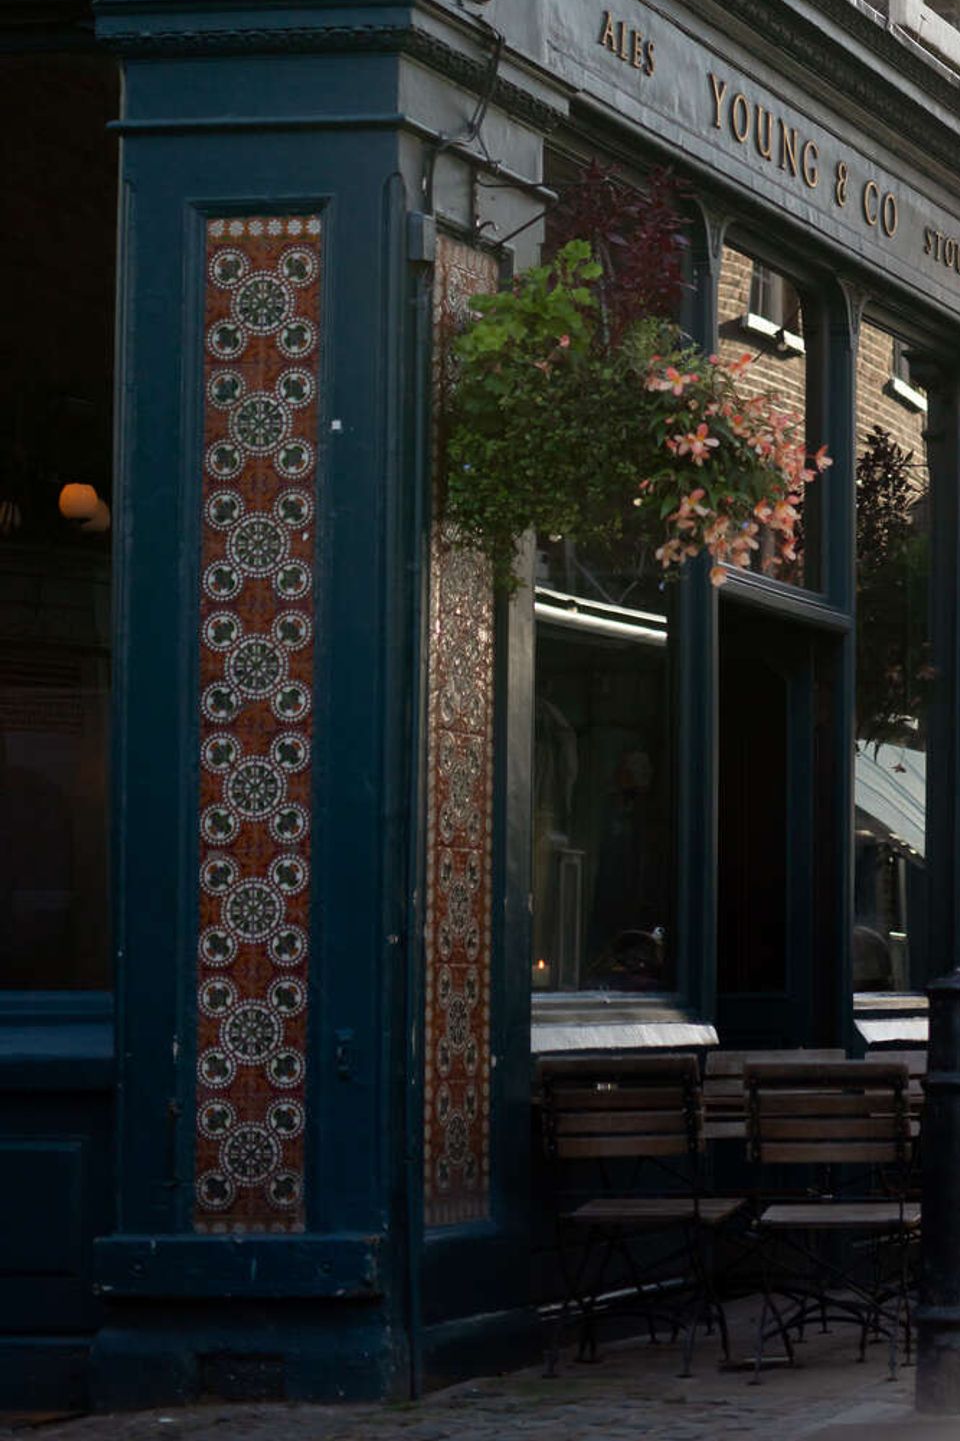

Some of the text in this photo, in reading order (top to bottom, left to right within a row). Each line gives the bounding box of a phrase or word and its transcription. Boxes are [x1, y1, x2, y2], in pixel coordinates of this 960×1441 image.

[600, 10, 657, 77] ALES
[708, 73, 820, 189] YOUNG
[835, 161, 849, 208] &
[863, 180, 899, 239] CO
